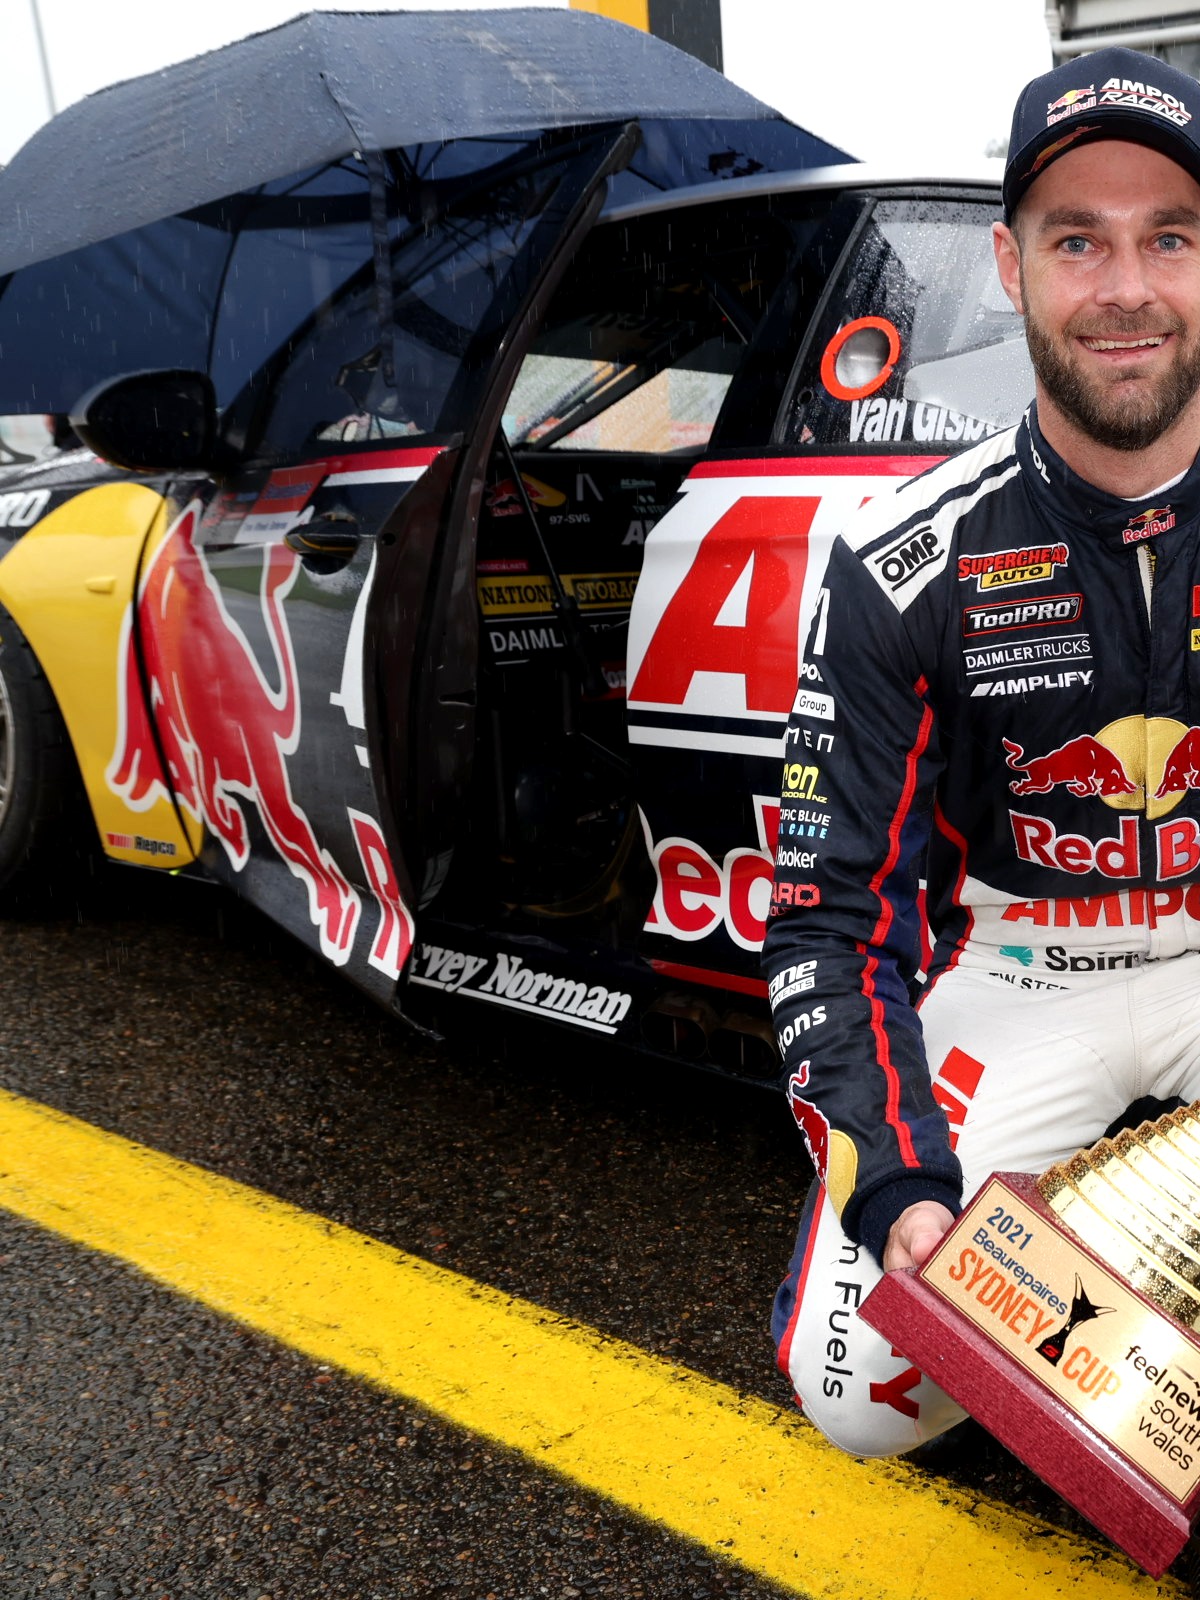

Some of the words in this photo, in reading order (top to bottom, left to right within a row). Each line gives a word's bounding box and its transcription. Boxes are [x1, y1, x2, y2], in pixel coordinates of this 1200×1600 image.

[1046, 105, 1073, 127] Red
[1072, 96, 1098, 116] Bull
[1100, 91, 1189, 126] RACING
[1102, 78, 1192, 119] AMPOL
[549, 512, 591, 525] 97-SVG
[1122, 524, 1150, 544] Red
[1150, 512, 1176, 538] Bull
[881, 532, 939, 582] OMP
[989, 566, 1044, 585] AUTO
[988, 670, 1094, 697] AMPLIFY
[799, 694, 827, 716] Group
[797, 809, 832, 827] BLUE
[812, 794, 828, 804] NZ
[788, 823, 828, 840] CARE
[1008, 808, 1141, 881] Red
[480, 952, 632, 1025] Norman
[986, 1206, 1035, 1250] 2021
[972, 1227, 1068, 1316] Beaurepaires
[822, 1280, 863, 1400] Fuels
[948, 1247, 1055, 1345] SYDNEY
[1061, 1346, 1122, 1401] CUP
[1124, 1345, 1161, 1387] feel
[1138, 1415, 1195, 1471] wales
